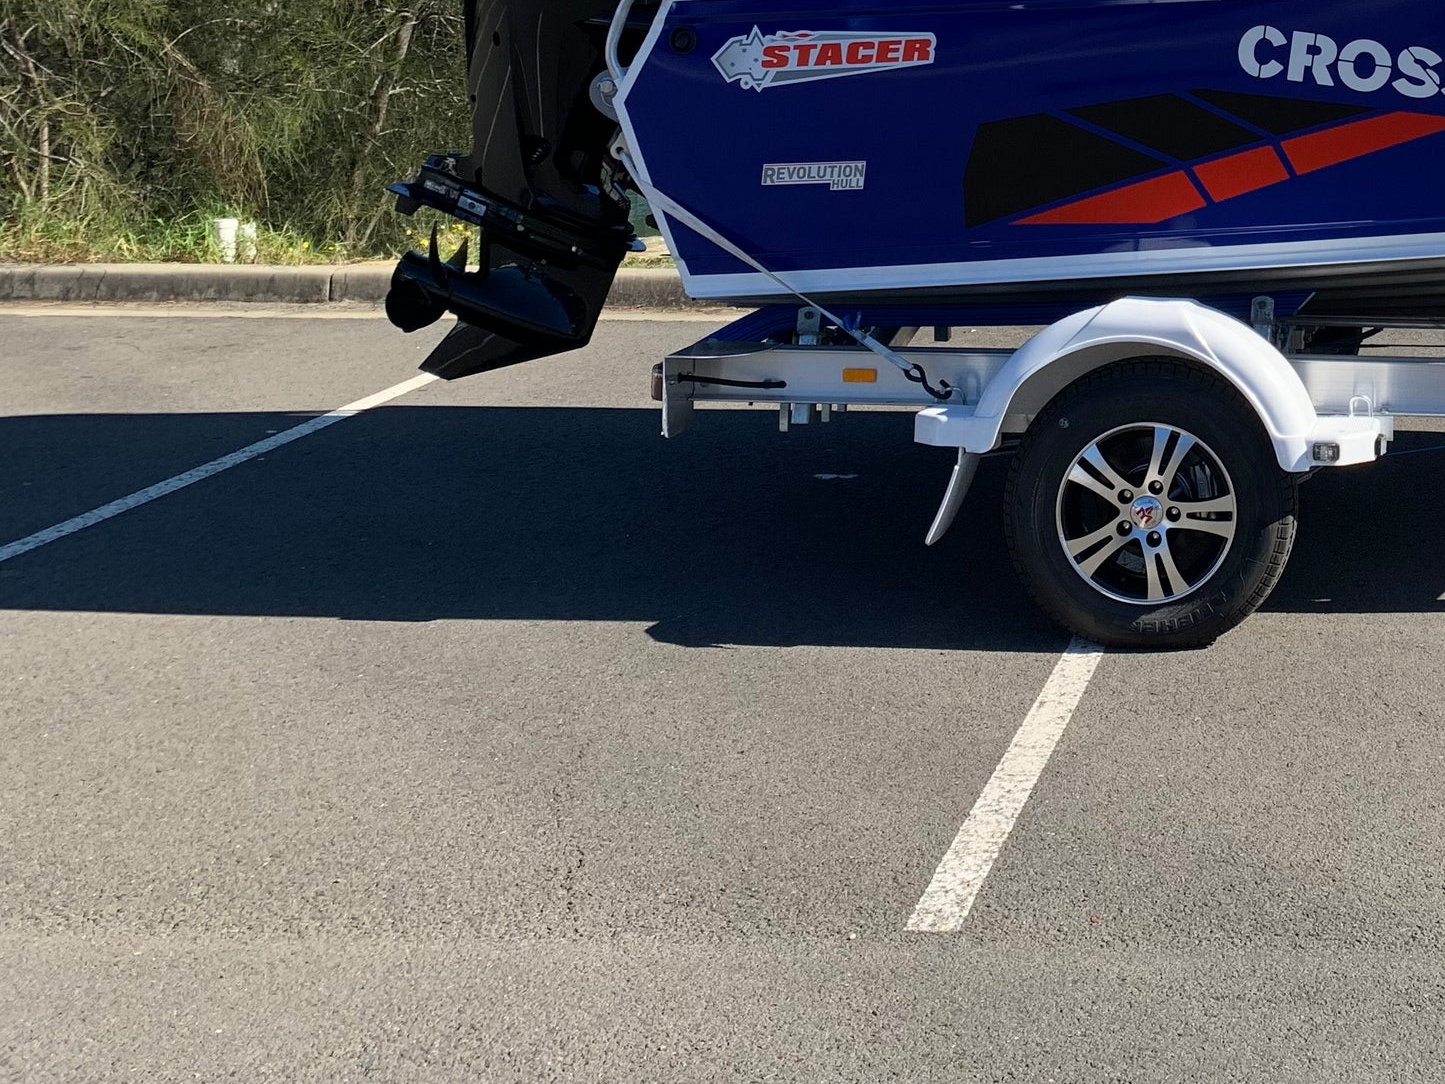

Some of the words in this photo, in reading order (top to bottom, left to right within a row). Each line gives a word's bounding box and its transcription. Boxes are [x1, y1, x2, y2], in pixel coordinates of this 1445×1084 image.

[761, 38, 932, 69] STACER
[762, 164, 864, 184] REVOLUTION
[831, 178, 863, 189] HULL
